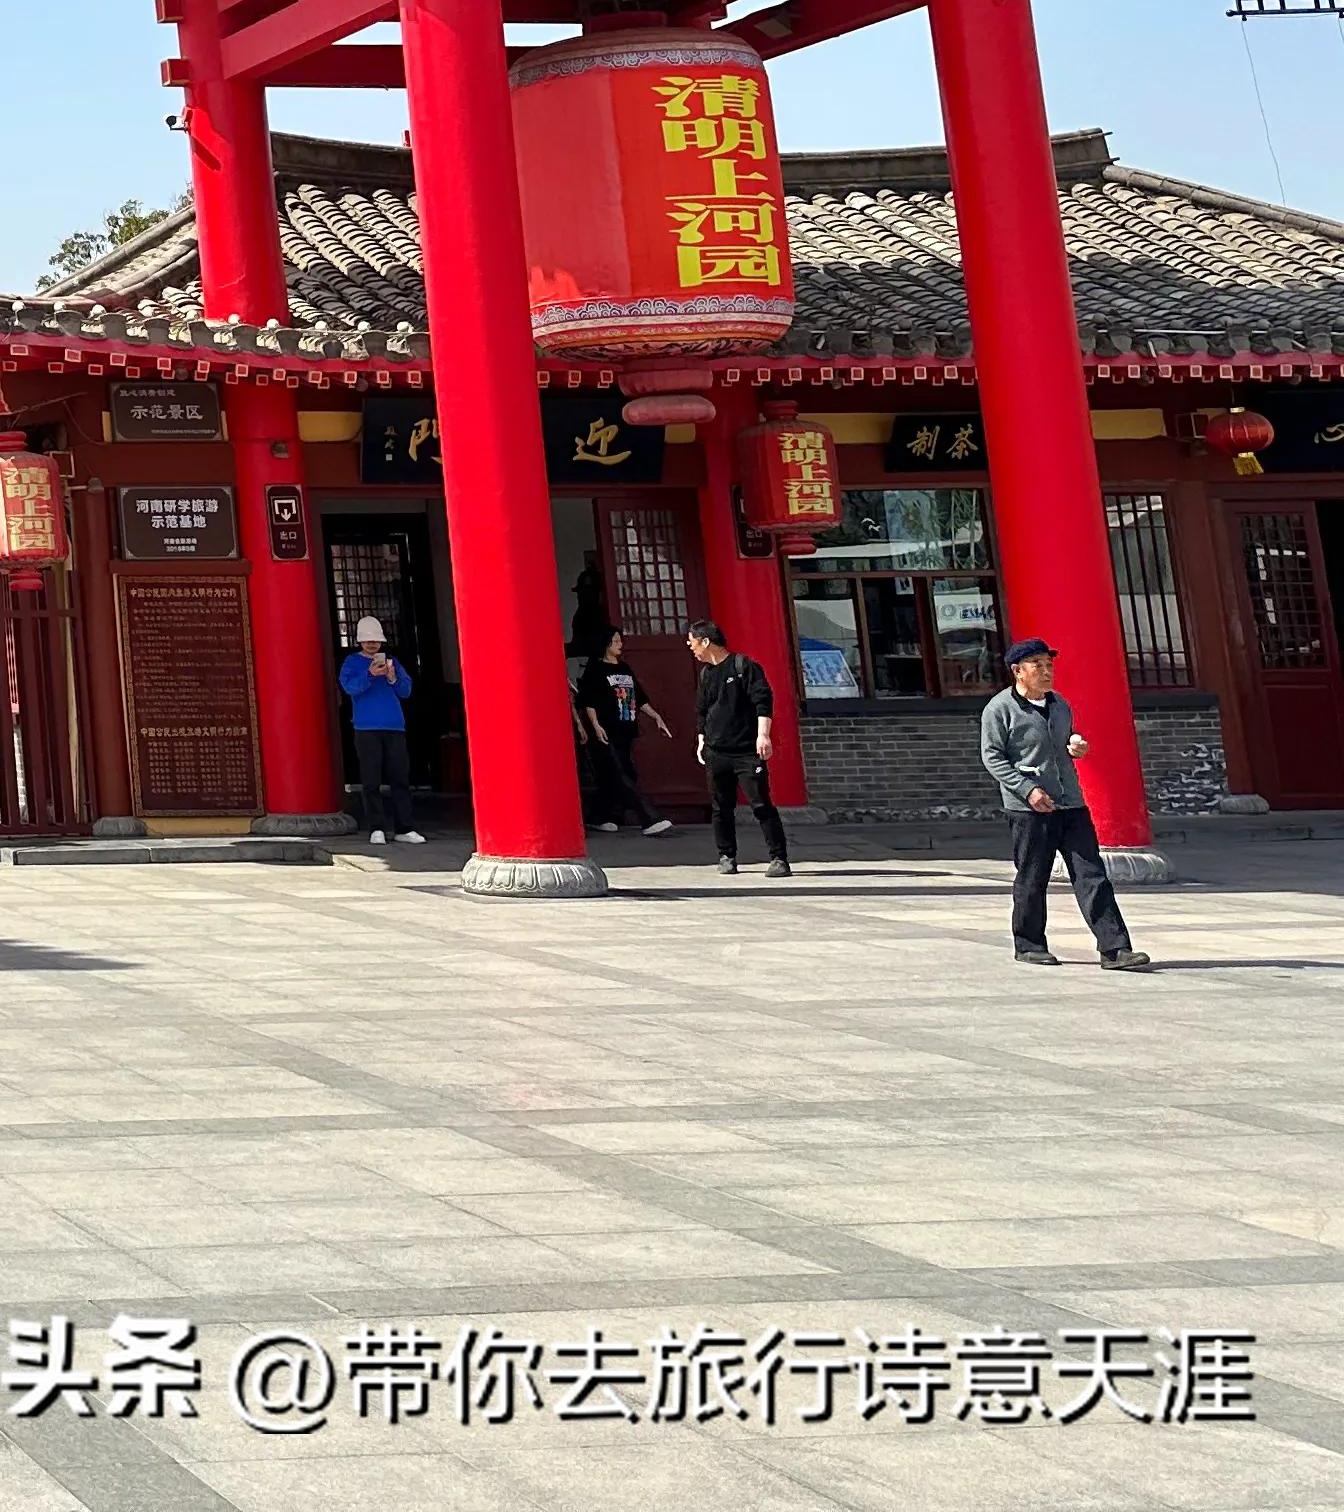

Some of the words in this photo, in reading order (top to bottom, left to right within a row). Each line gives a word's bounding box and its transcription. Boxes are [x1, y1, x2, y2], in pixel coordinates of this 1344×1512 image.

[650, 74, 781, 288] 清明上河园
[130, 404, 203, 419] 示范景区
[777, 431, 834, 515] 清明上河园
[2, 467, 55, 551] 清明上河园
[136, 499, 219, 513] 河南研学旅游
[151, 514, 207, 528] 示范基地
[279, 530, 297, 540] 出口
